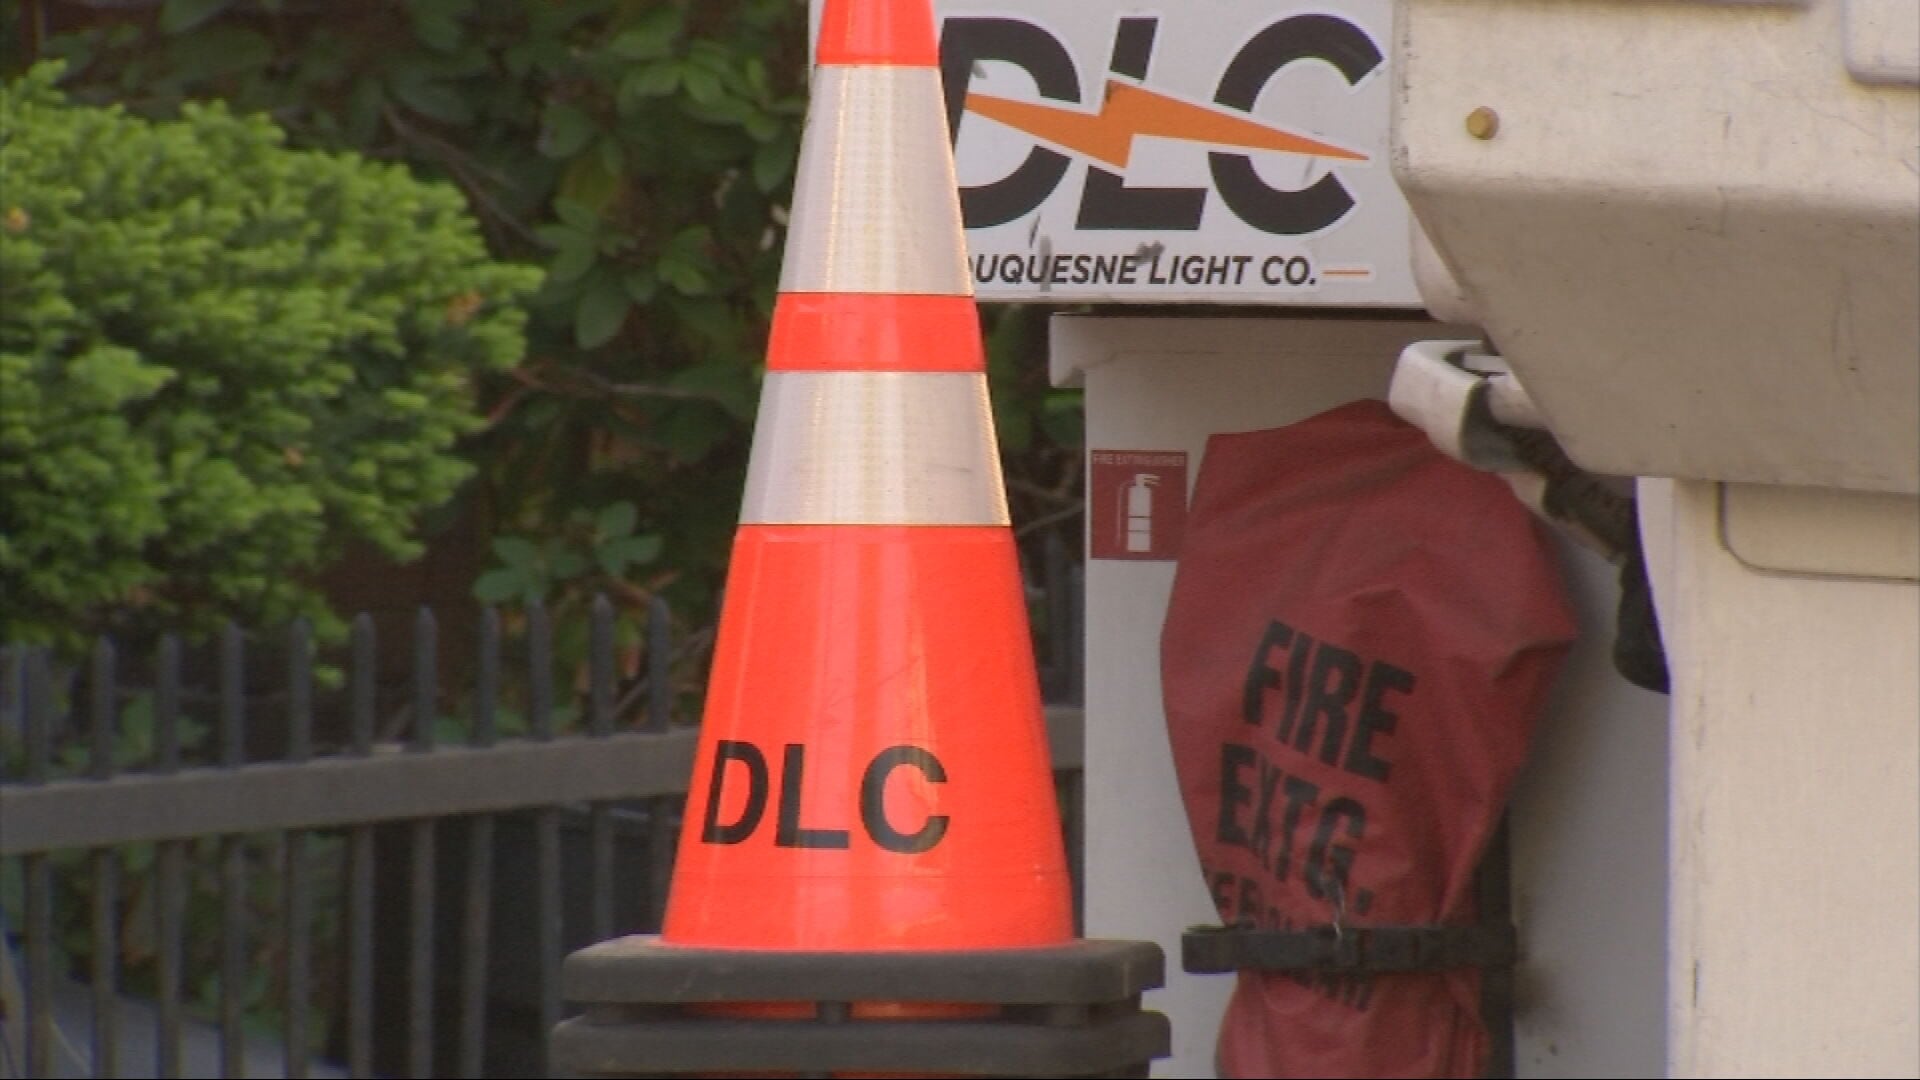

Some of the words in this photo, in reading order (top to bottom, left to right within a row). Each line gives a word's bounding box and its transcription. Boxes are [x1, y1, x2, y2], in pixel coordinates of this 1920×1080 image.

[938, 14, 1384, 235] DLC
[968, 254, 1139, 285] UQUESNE
[1149, 255, 1253, 285] LIGHT
[1261, 255, 1316, 285] CO.
[1244, 619, 1417, 782] FIRE
[702, 740, 950, 854] DLC
[1216, 742, 1376, 915] EXTG.
